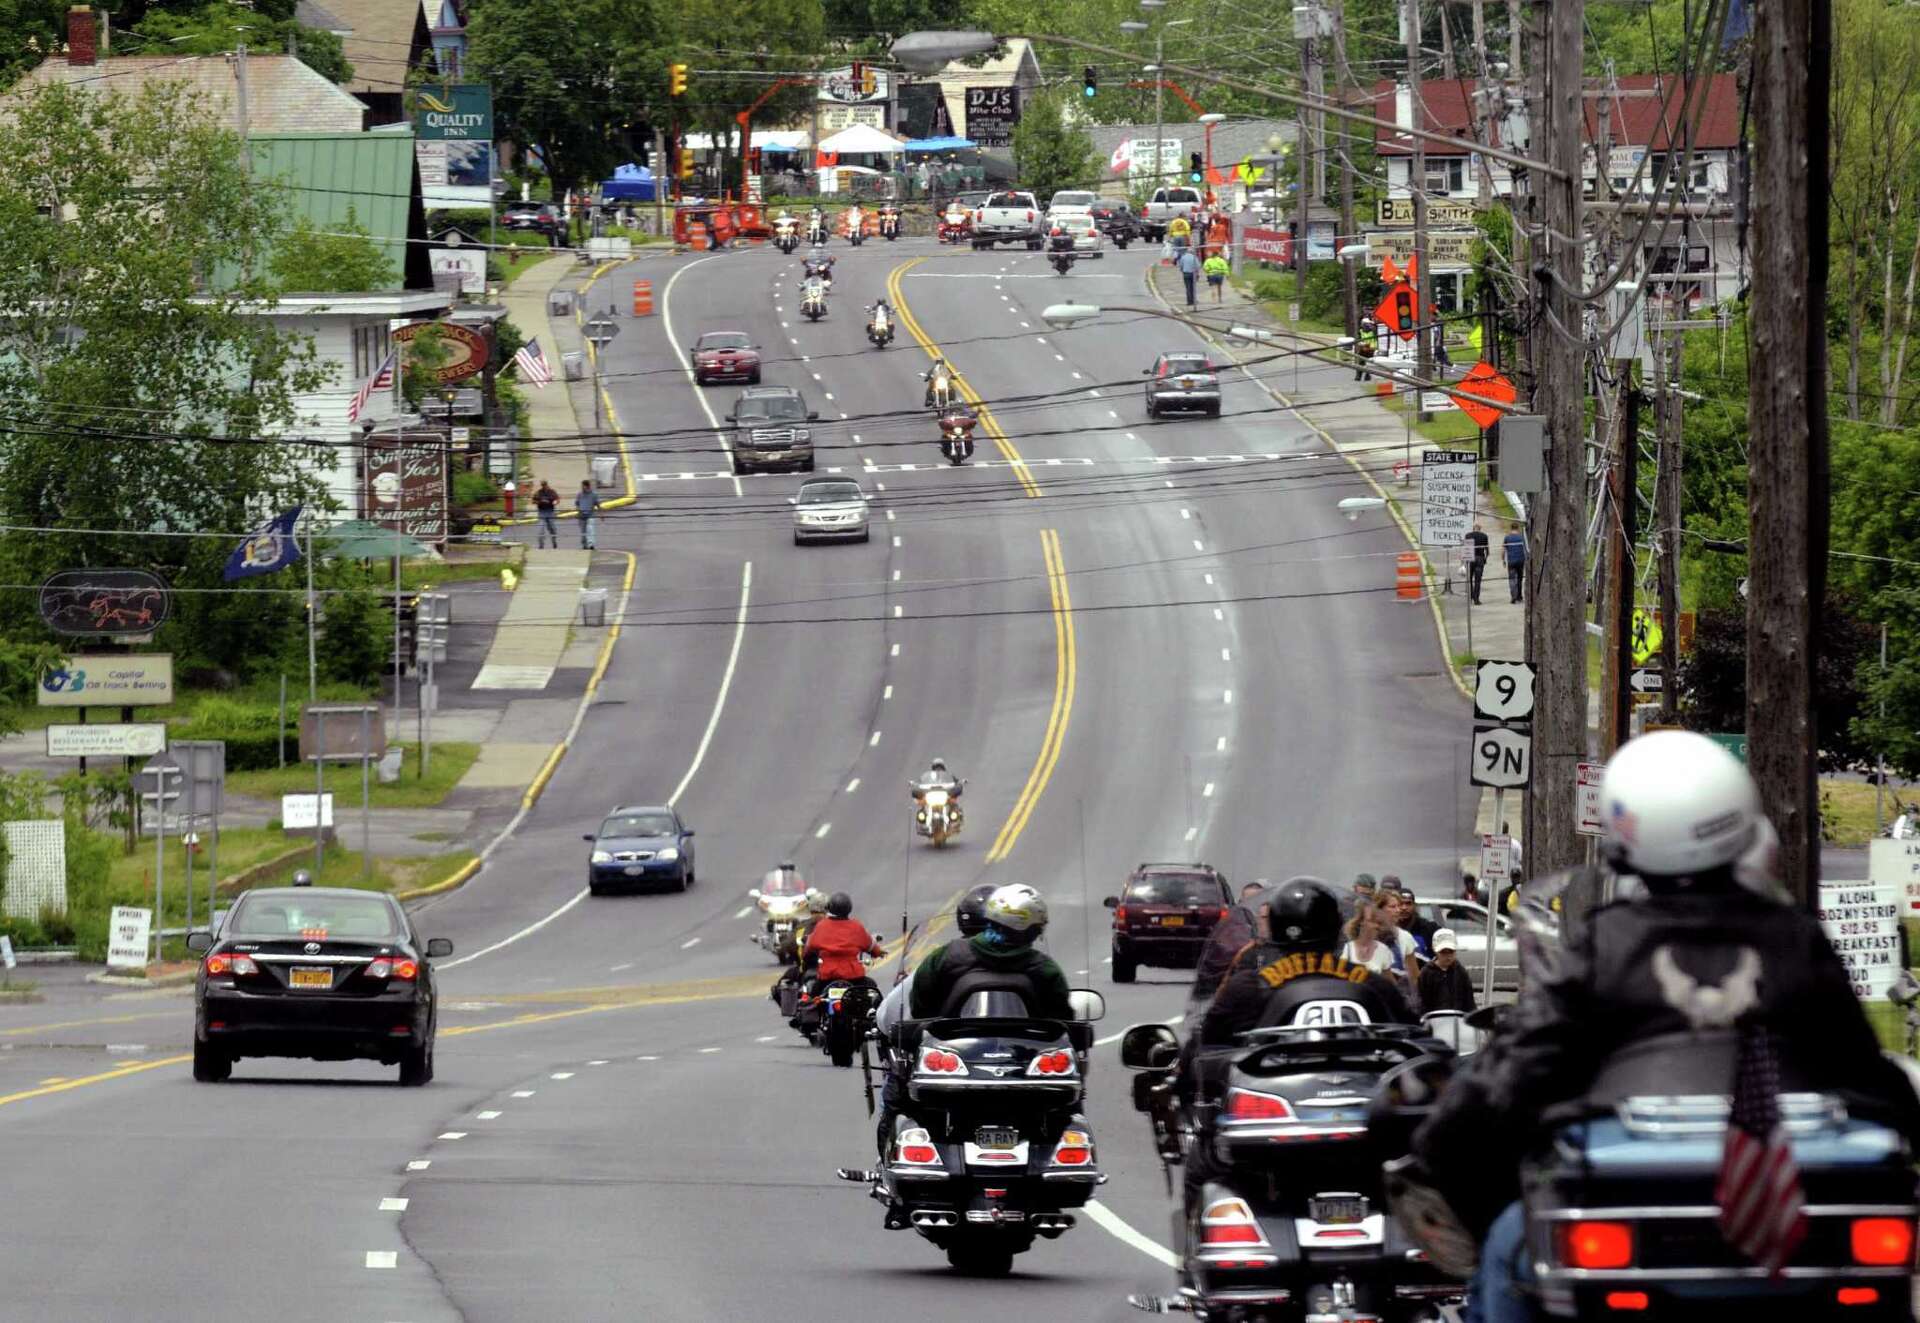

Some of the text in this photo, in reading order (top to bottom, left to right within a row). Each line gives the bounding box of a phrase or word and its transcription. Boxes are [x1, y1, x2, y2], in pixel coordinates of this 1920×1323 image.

[971, 89, 1010, 105] DJ's
[427, 112, 484, 127] QUALITY
[370, 443, 440, 470] Smokey
[1426, 453, 1476, 462] STATE LAW
[404, 459, 440, 479] Joe's
[1433, 472, 1463, 480] LICENSE
[1427, 483, 1471, 493] SUSPENDED
[1429, 495, 1470, 505] AFTER TWO
[1426, 508, 1445, 516] WORK
[406, 520, 442, 536] Grill
[1428, 519, 1465, 528] SPEEDING
[1433, 531, 1463, 540] TICKETS
[1643, 677, 1661, 685] ONE
[1495, 675, 1517, 706] 9
[1480, 740, 1523, 775] 9N
[1838, 891, 1877, 905] ALOHA
[1863, 905, 1897, 918] STRIP
[1840, 921, 1879, 935] $12.95
[1832, 936, 1898, 951] REAKFAST
[1864, 953, 1891, 965] 7AM
[1259, 952, 1369, 988] BUFFALO
[995, 1132, 1014, 1144] RAY
